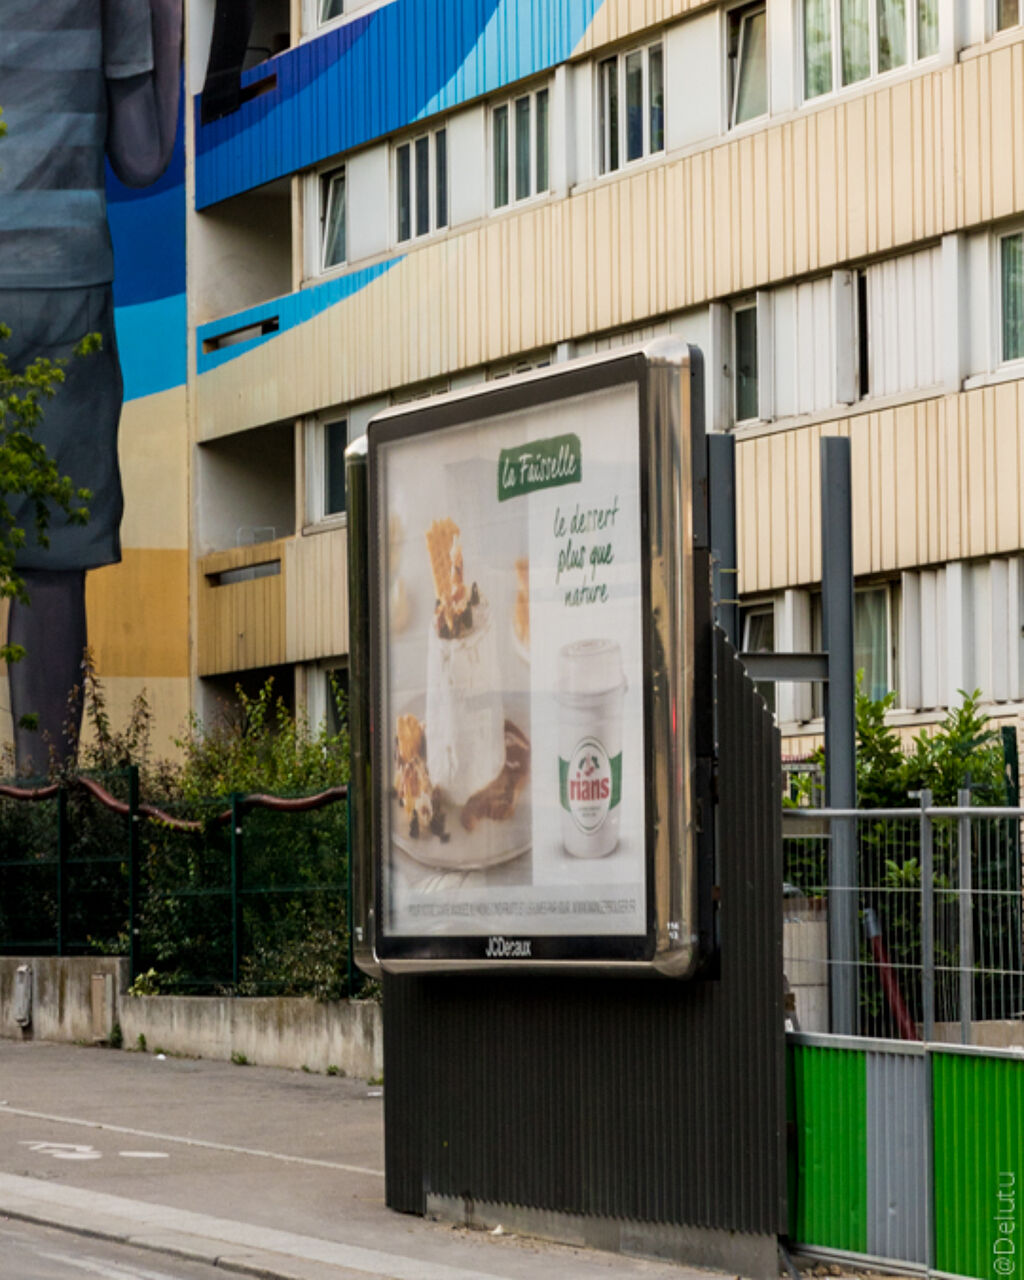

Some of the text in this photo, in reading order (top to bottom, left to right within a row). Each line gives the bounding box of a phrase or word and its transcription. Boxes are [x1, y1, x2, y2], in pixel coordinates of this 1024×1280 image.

[519, 444, 577, 485] Faisselle
[555, 538, 614, 584] plus que
[564, 575, 608, 607] nature
[570, 771, 609, 801] rians
[486, 937, 531, 957] JCDecaux
